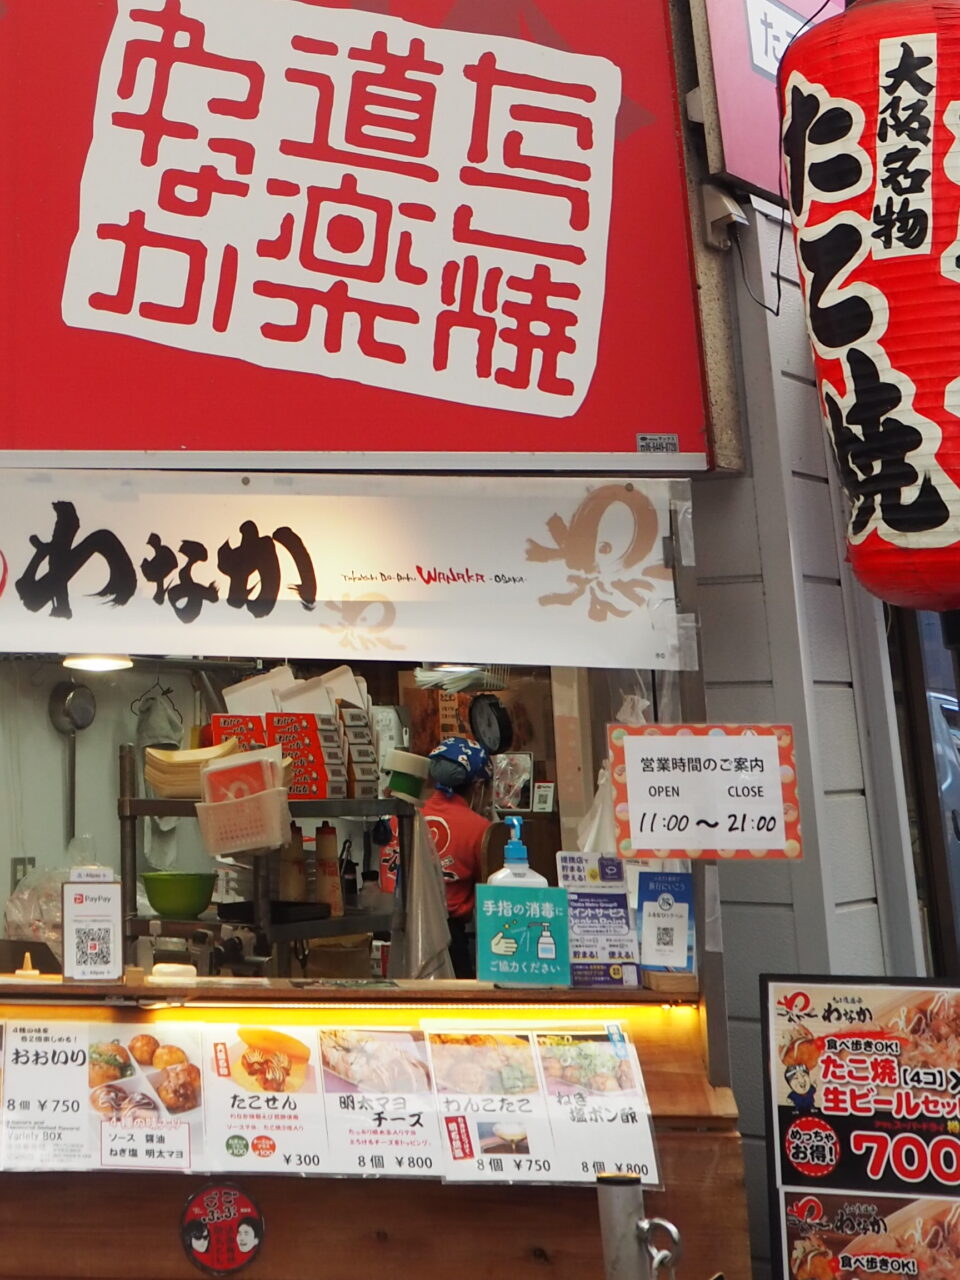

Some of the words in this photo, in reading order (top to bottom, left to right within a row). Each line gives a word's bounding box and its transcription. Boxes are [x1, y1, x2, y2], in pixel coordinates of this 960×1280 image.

[868, 41, 936, 251] 大阪名物
[783, 83, 951, 535] たこ焼
[15, 500, 318, 624] わなか
[415, 564, 486, 585] WANAKA
[640, 756, 765, 773] 営業時間のご案内
[648, 785, 680, 798] OPEN
[727, 785, 765, 798] CLOSE
[84, 894, 112, 904] PayPay
[482, 898, 564, 920] 手指の消毒に
[489, 959, 561, 975] ご協力ください
[821, 1002, 873, 1024] わなか
[826, 1038, 899, 1053] 食べ歩きOK!
[11, 1047, 87, 1067] おおいり
[821, 1055, 898, 1084] たこ焼
[229, 1093, 298, 1111] たこせん
[339, 1094, 407, 1111] 明太マヨ
[372, 1111, 425, 1128] チーズ
[569, 1107, 638, 1124] 塩ポン酢
[43, 1131, 63, 1142] BOX
[109, 1133, 135, 1142] ソース
[790, 1128, 835, 1144] めっちゃ
[145, 1148, 184, 1159] 明太マヨ
[283, 1154, 321, 1167] ¥300
[790, 1143, 836, 1164] お得!
[840, 1255, 916, 1273] 食べ歩きOK!
